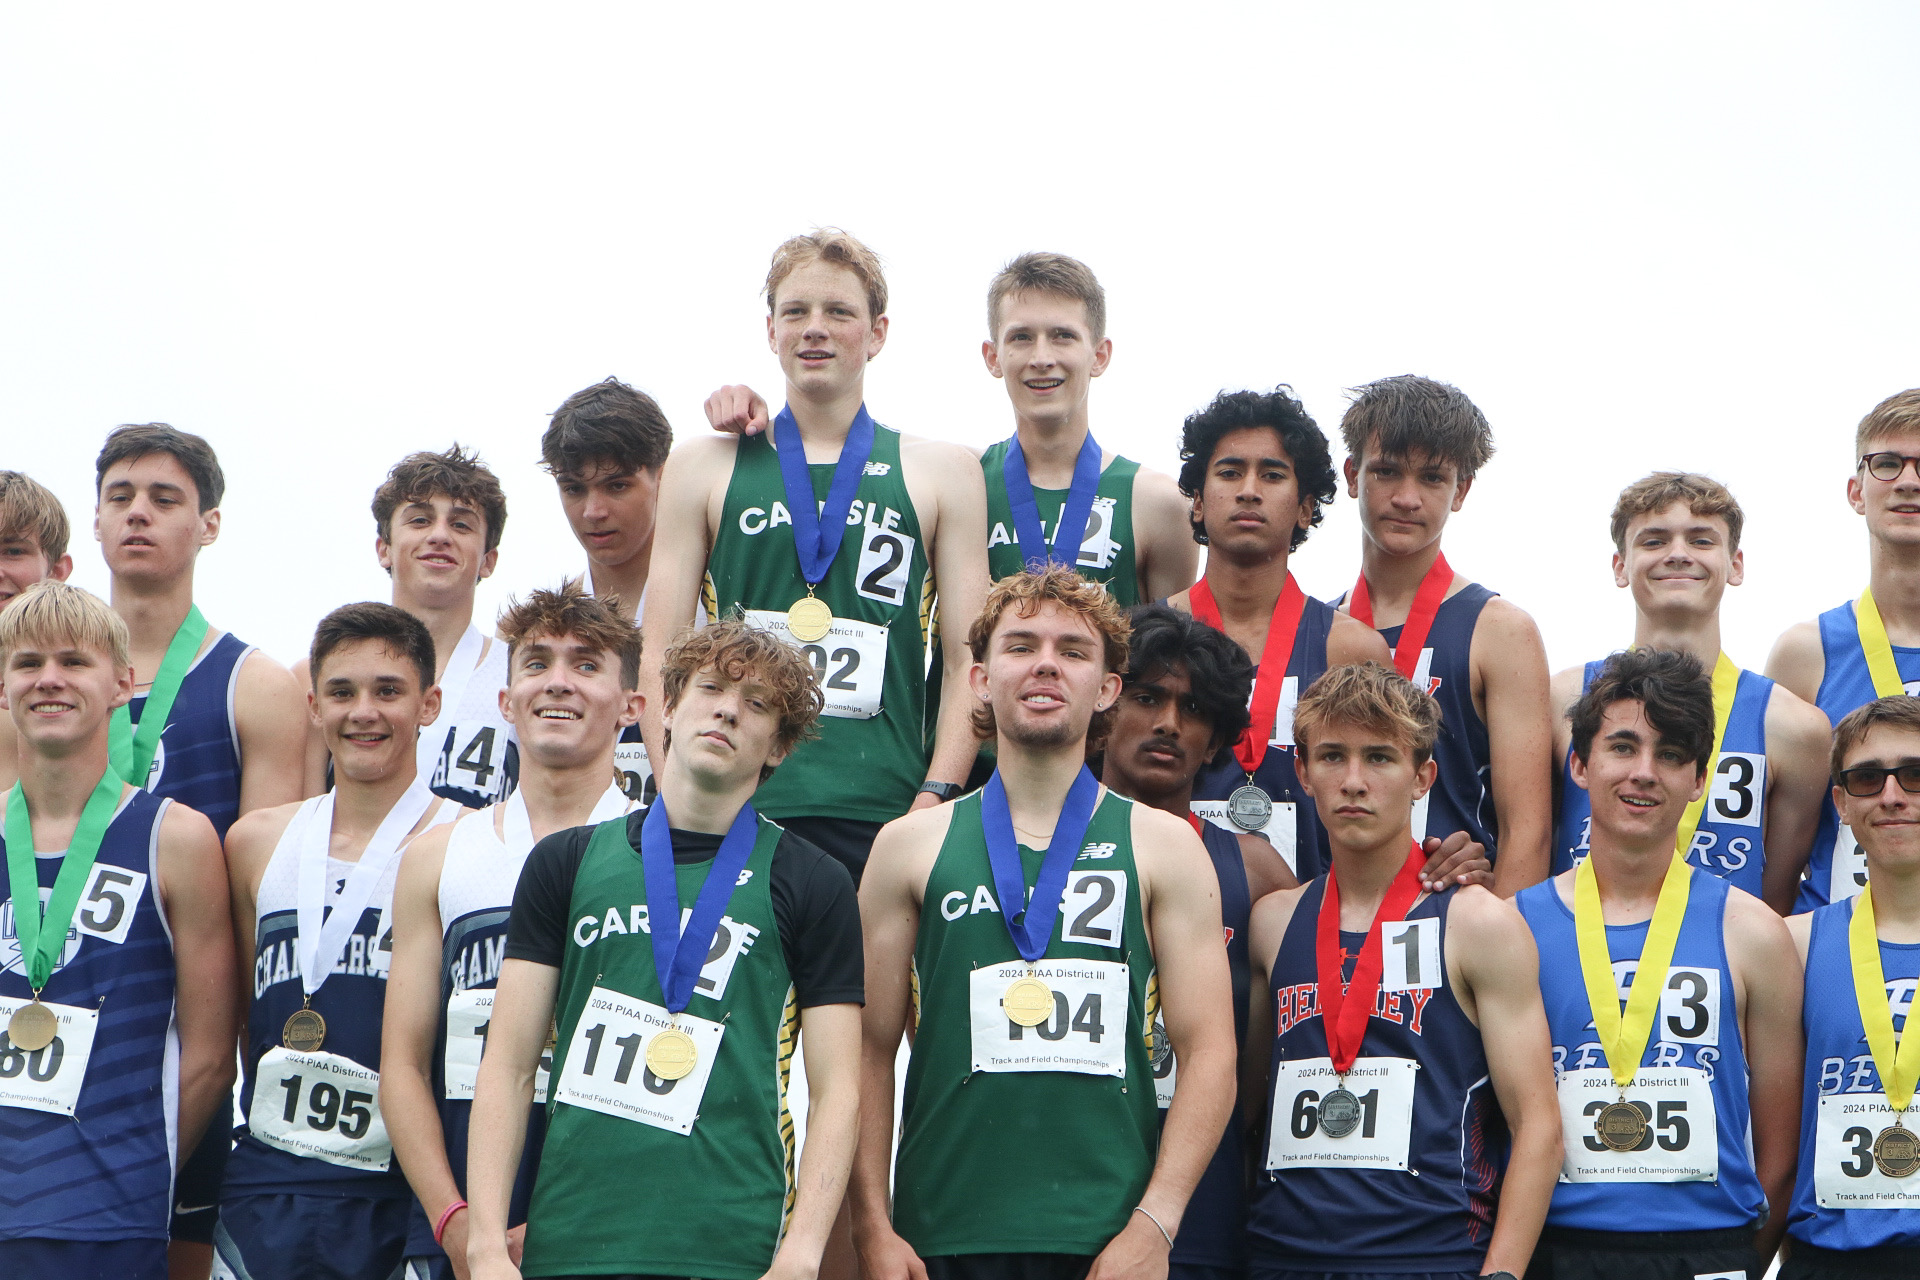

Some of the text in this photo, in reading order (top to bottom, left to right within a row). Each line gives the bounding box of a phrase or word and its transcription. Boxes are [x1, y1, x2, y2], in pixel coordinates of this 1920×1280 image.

[739, 500, 901, 535] CASLE
[861, 534, 904, 599] 2
[825, 702, 862, 713] pionships
[456, 726, 496, 787] 4
[1714, 756, 1754, 819] 3
[1199, 810, 1223, 818] PIAA
[1077, 842, 1117, 861] NB
[735, 869, 754, 886] B
[80, 869, 134, 933] 5
[1069, 875, 1116, 941] 2
[1392, 924, 1421, 985] 1
[999, 969, 1024, 978] 2024
[1056, 968, 1094, 980] District
[1096, 971, 1105, 980] III
[475, 998, 493, 1006] 202
[591, 998, 613, 1012] 2024
[615, 1004, 641, 1021] PIAA
[644, 1013, 682, 1031] Distrt
[1277, 982, 1434, 1040] HEEY
[1667, 971, 1710, 1039] 3
[285, 1052, 305, 1065] 2024
[306, 1058, 329, 1072] PIAA
[331, 1065, 368, 1080] District
[990, 1055, 1110, 1069] Track and Field Championships
[1297, 1068, 1316, 1078] 2024
[1380, 1067, 1389, 1076] III
[460, 1083, 476, 1092] Trac
[1583, 1077, 1689, 1088] 2024 PA District III
[280, 1074, 373, 1140] 195
[594, 1094, 613, 1105] Field
[613, 1099, 675, 1122] Championships
[1290, 1088, 1379, 1140] 61
[1843, 1104, 1866, 1114] 2024
[262, 1131, 372, 1163] Track and Field Championships
[1282, 1154, 1298, 1162] Track
[1299, 1153, 1312, 1161] and
[1333, 1153, 1390, 1162] Championships
[1577, 1166, 1701, 1175] Track and Field Championships
